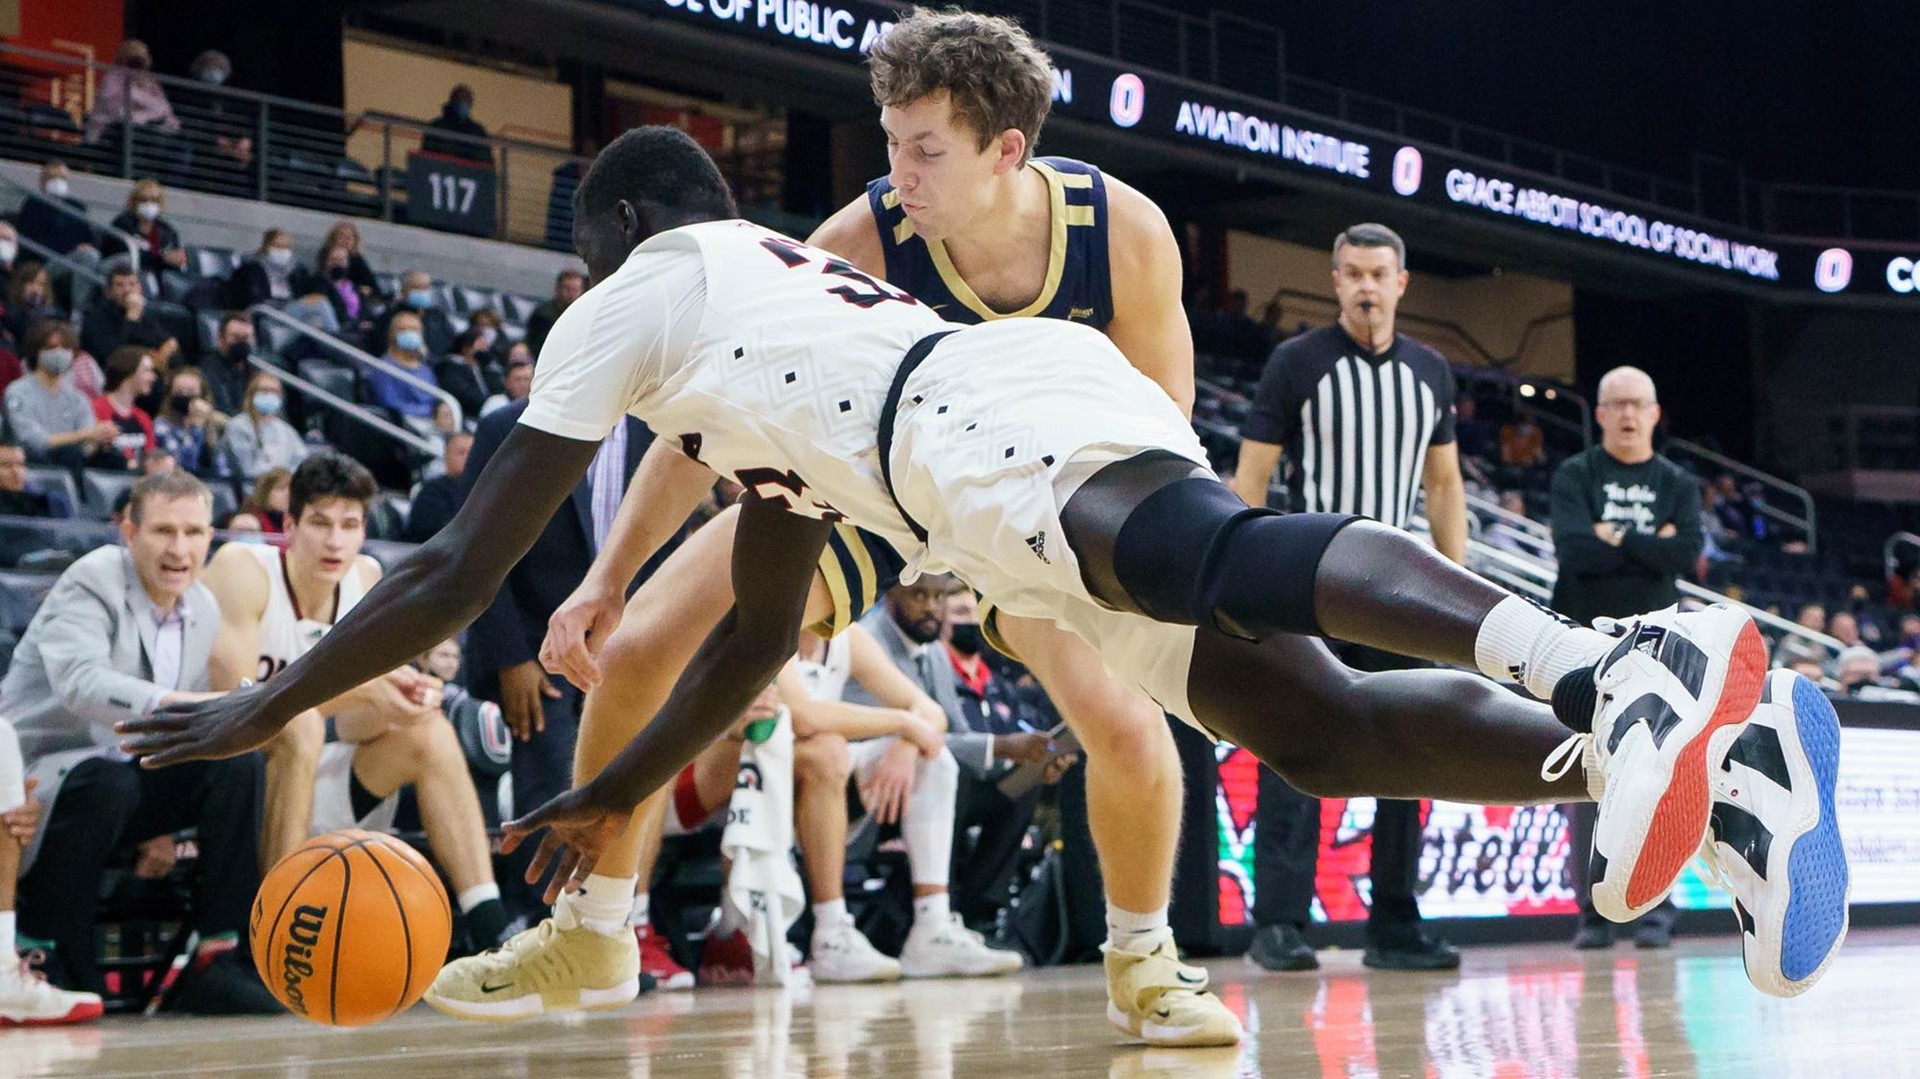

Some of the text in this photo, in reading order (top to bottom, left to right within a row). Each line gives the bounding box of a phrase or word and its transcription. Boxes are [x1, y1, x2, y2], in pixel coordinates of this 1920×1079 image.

[757, 0, 856, 49] PUBLIC
[1175, 101, 1371, 179] AVIATION INSTITUTE
[428, 172, 476, 214] 117
[1445, 168, 1514, 214] GRACE
[1579, 203, 1650, 249] SCHOOL
[1650, 221, 1675, 253] OF
[1674, 227, 1733, 269] SOCIAL
[1731, 241, 1780, 281] WORK
